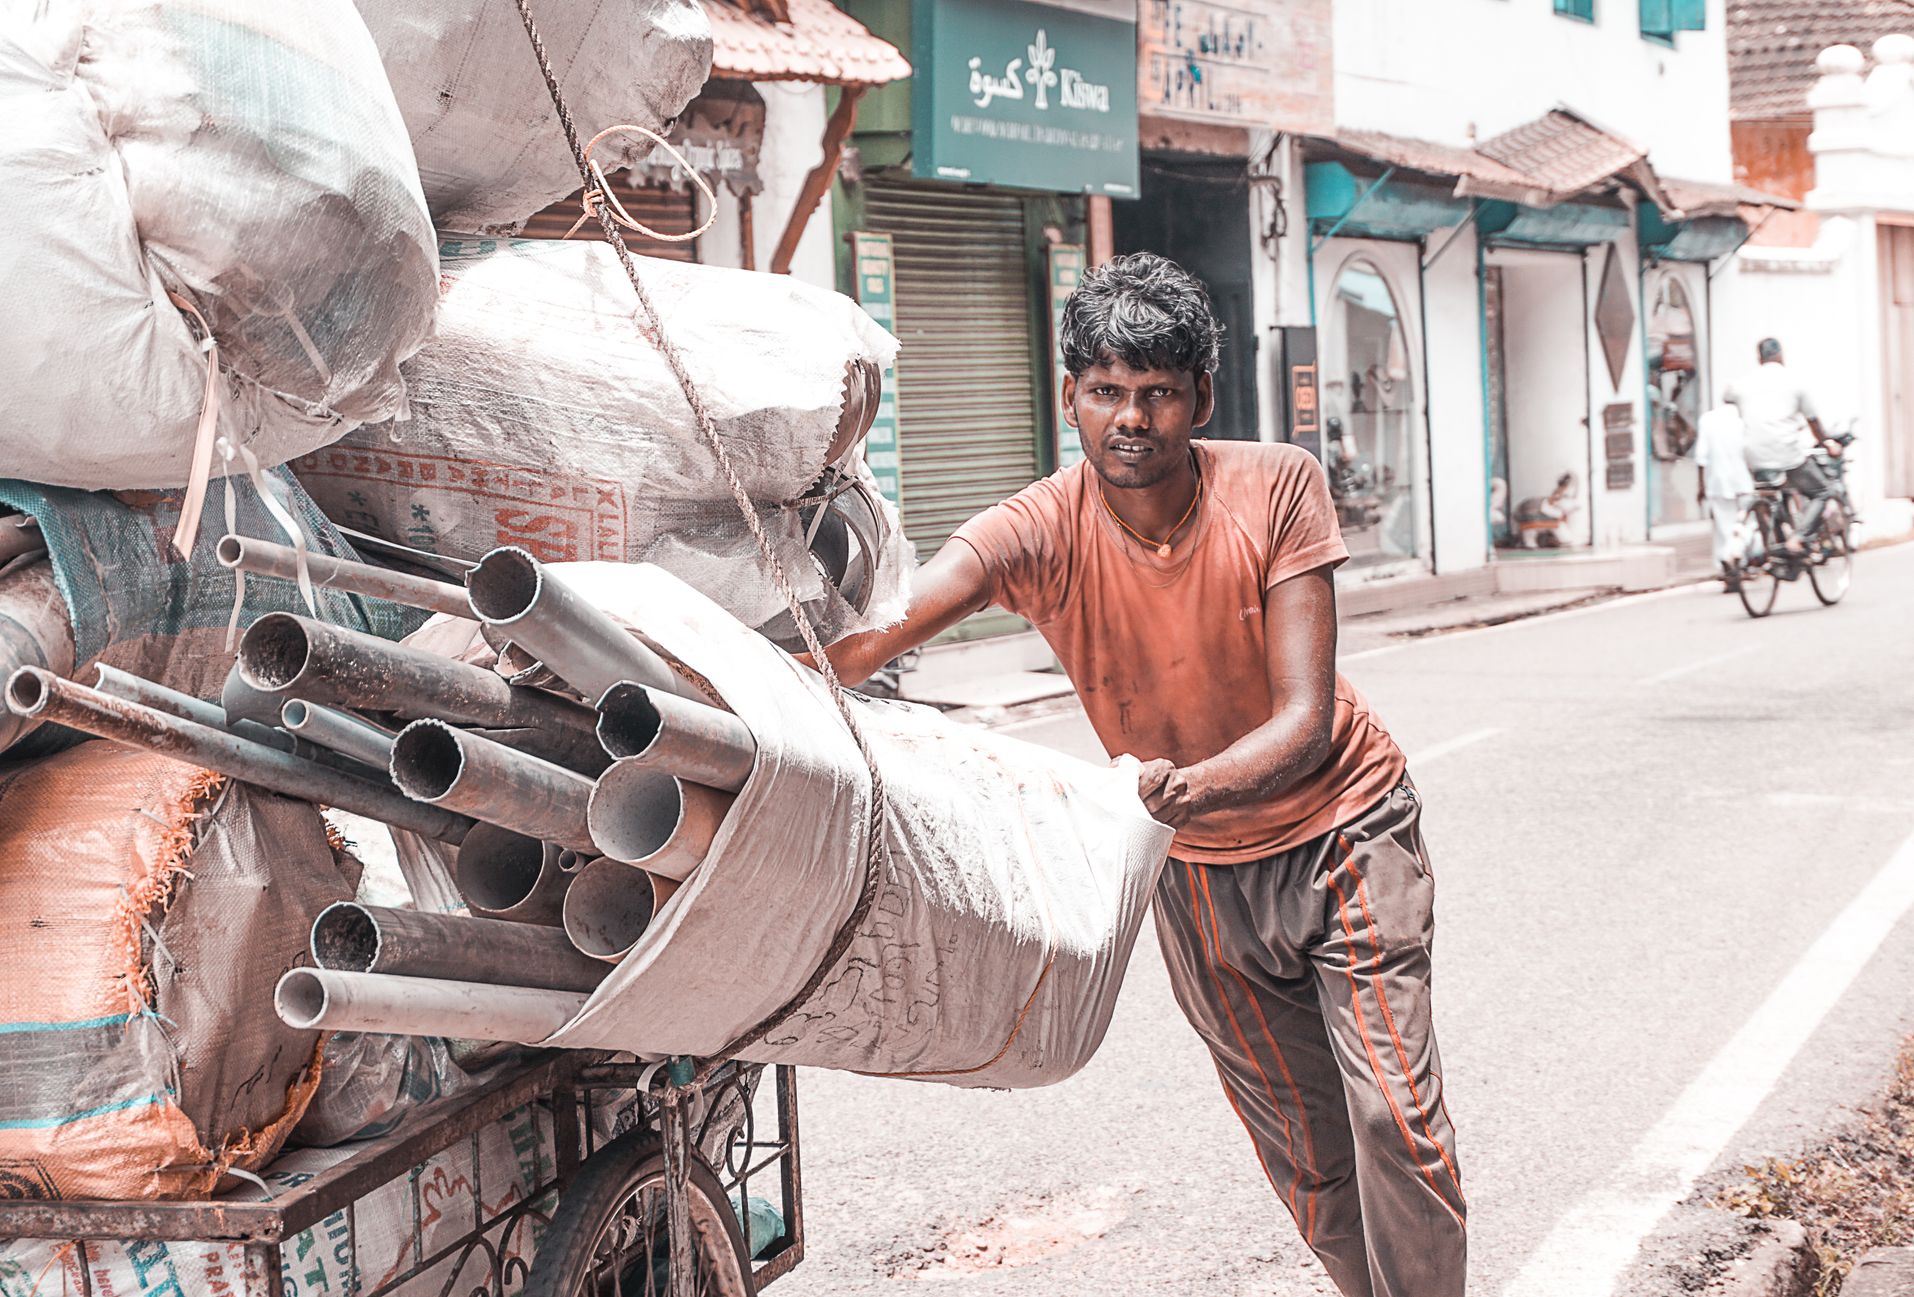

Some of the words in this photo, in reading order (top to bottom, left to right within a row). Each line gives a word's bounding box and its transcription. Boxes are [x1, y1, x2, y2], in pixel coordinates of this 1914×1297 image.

[968, 56, 1024, 108] كسوة
[1060, 68, 1109, 112] Kiswa
[328, 453, 437, 481] BRAND
